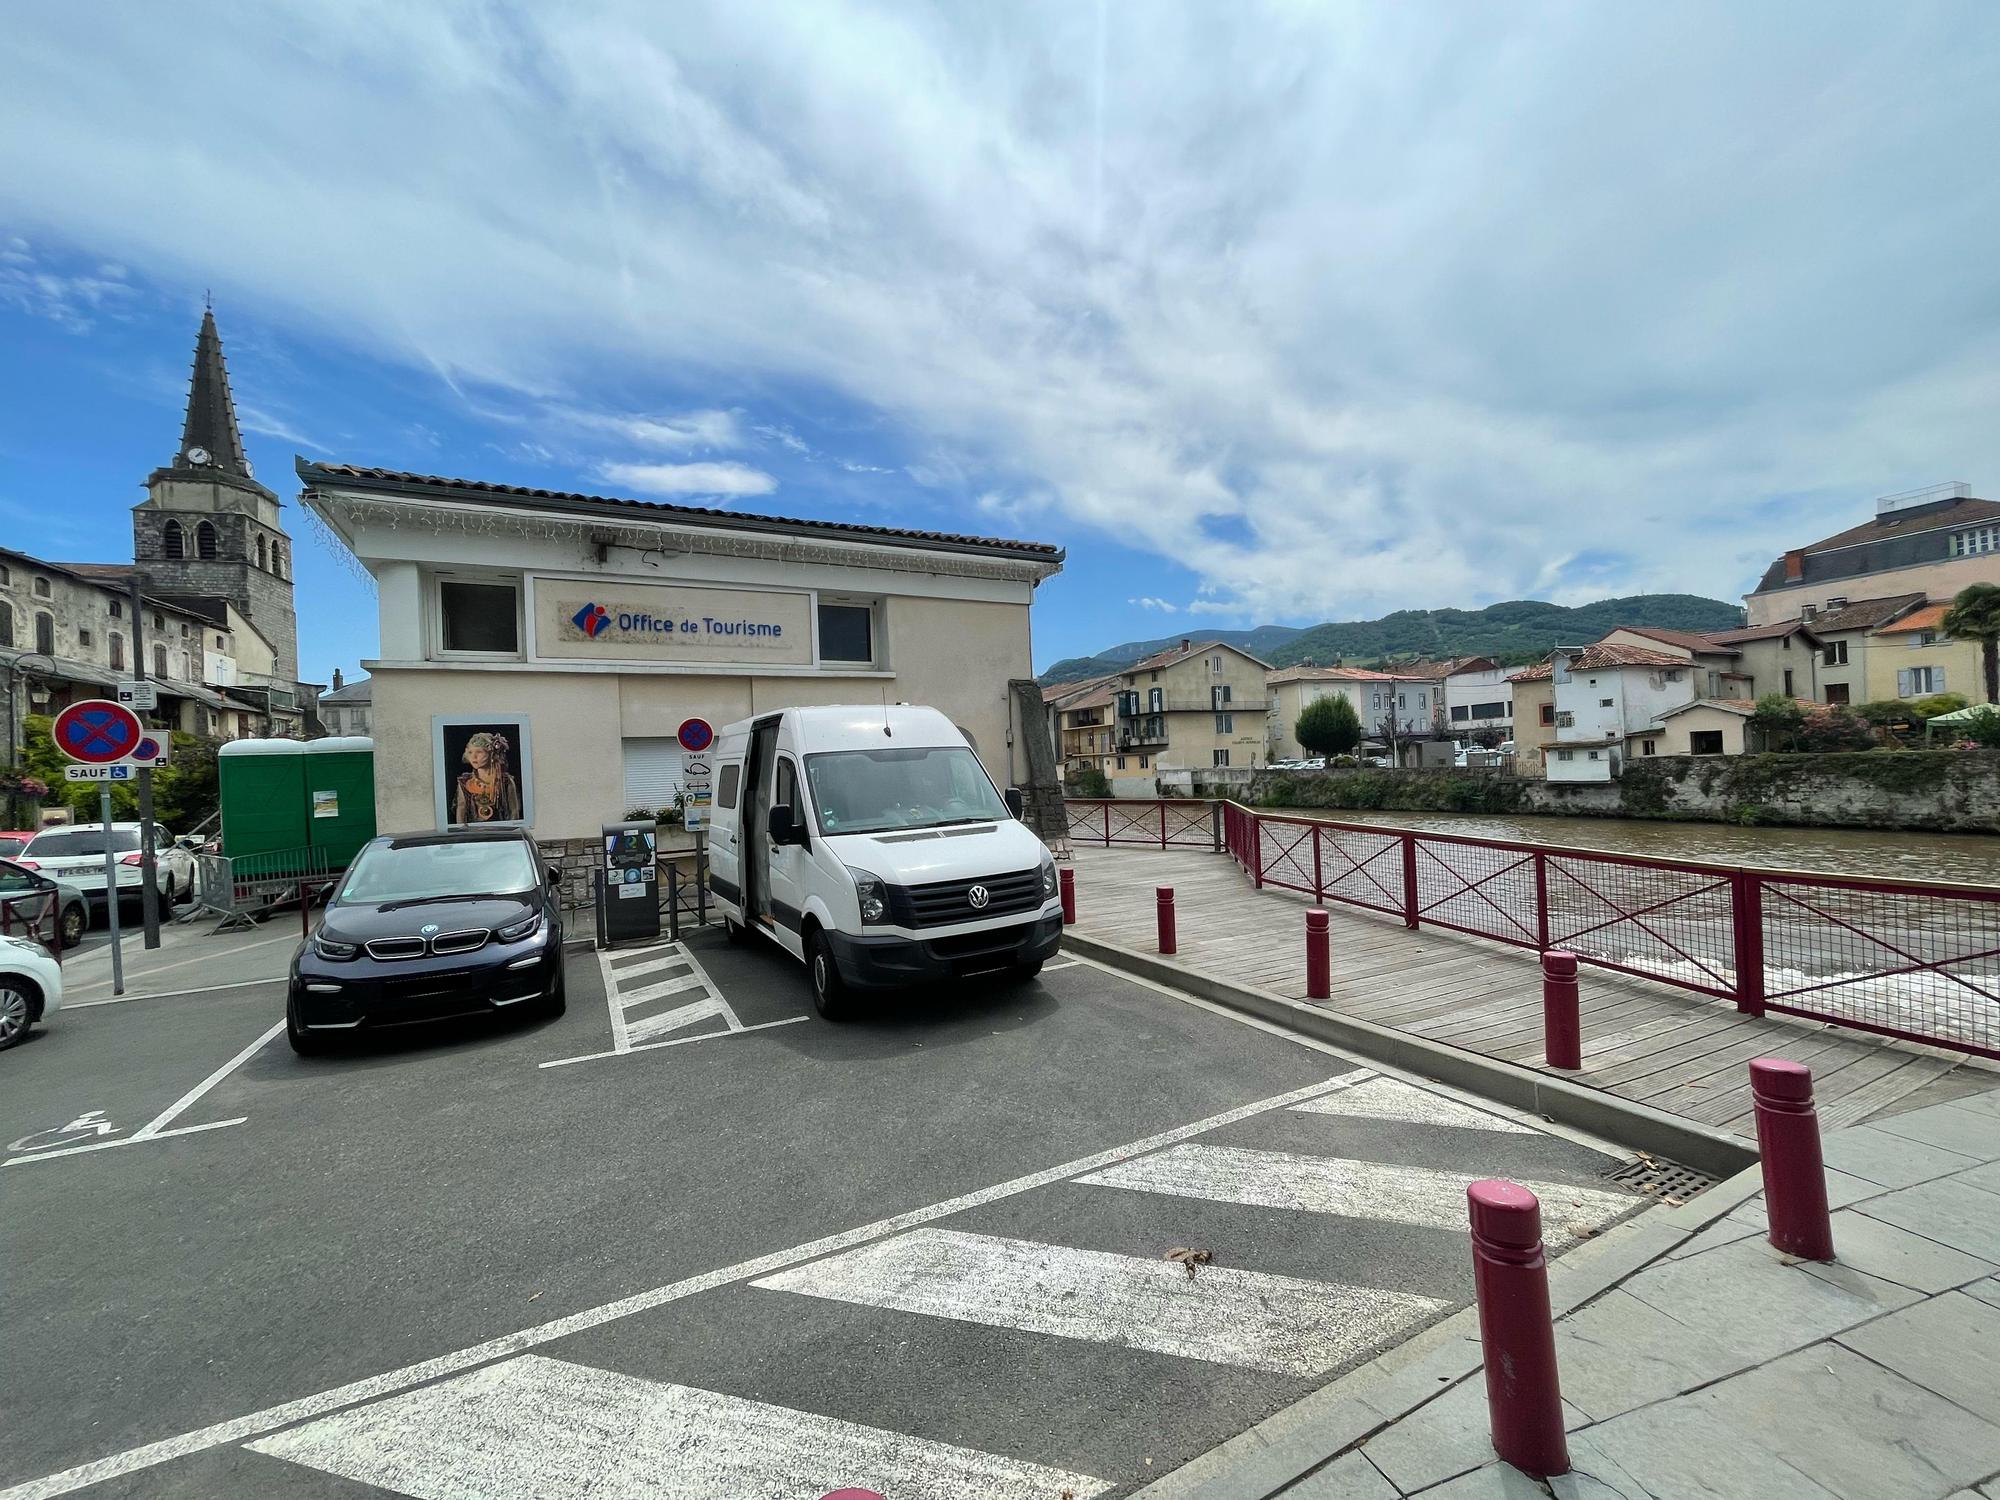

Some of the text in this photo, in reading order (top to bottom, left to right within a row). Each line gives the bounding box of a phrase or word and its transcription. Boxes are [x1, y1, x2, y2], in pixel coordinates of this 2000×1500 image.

[619, 613, 782, 637] Office de Tourisme
[69, 768, 108, 778] SAUF
